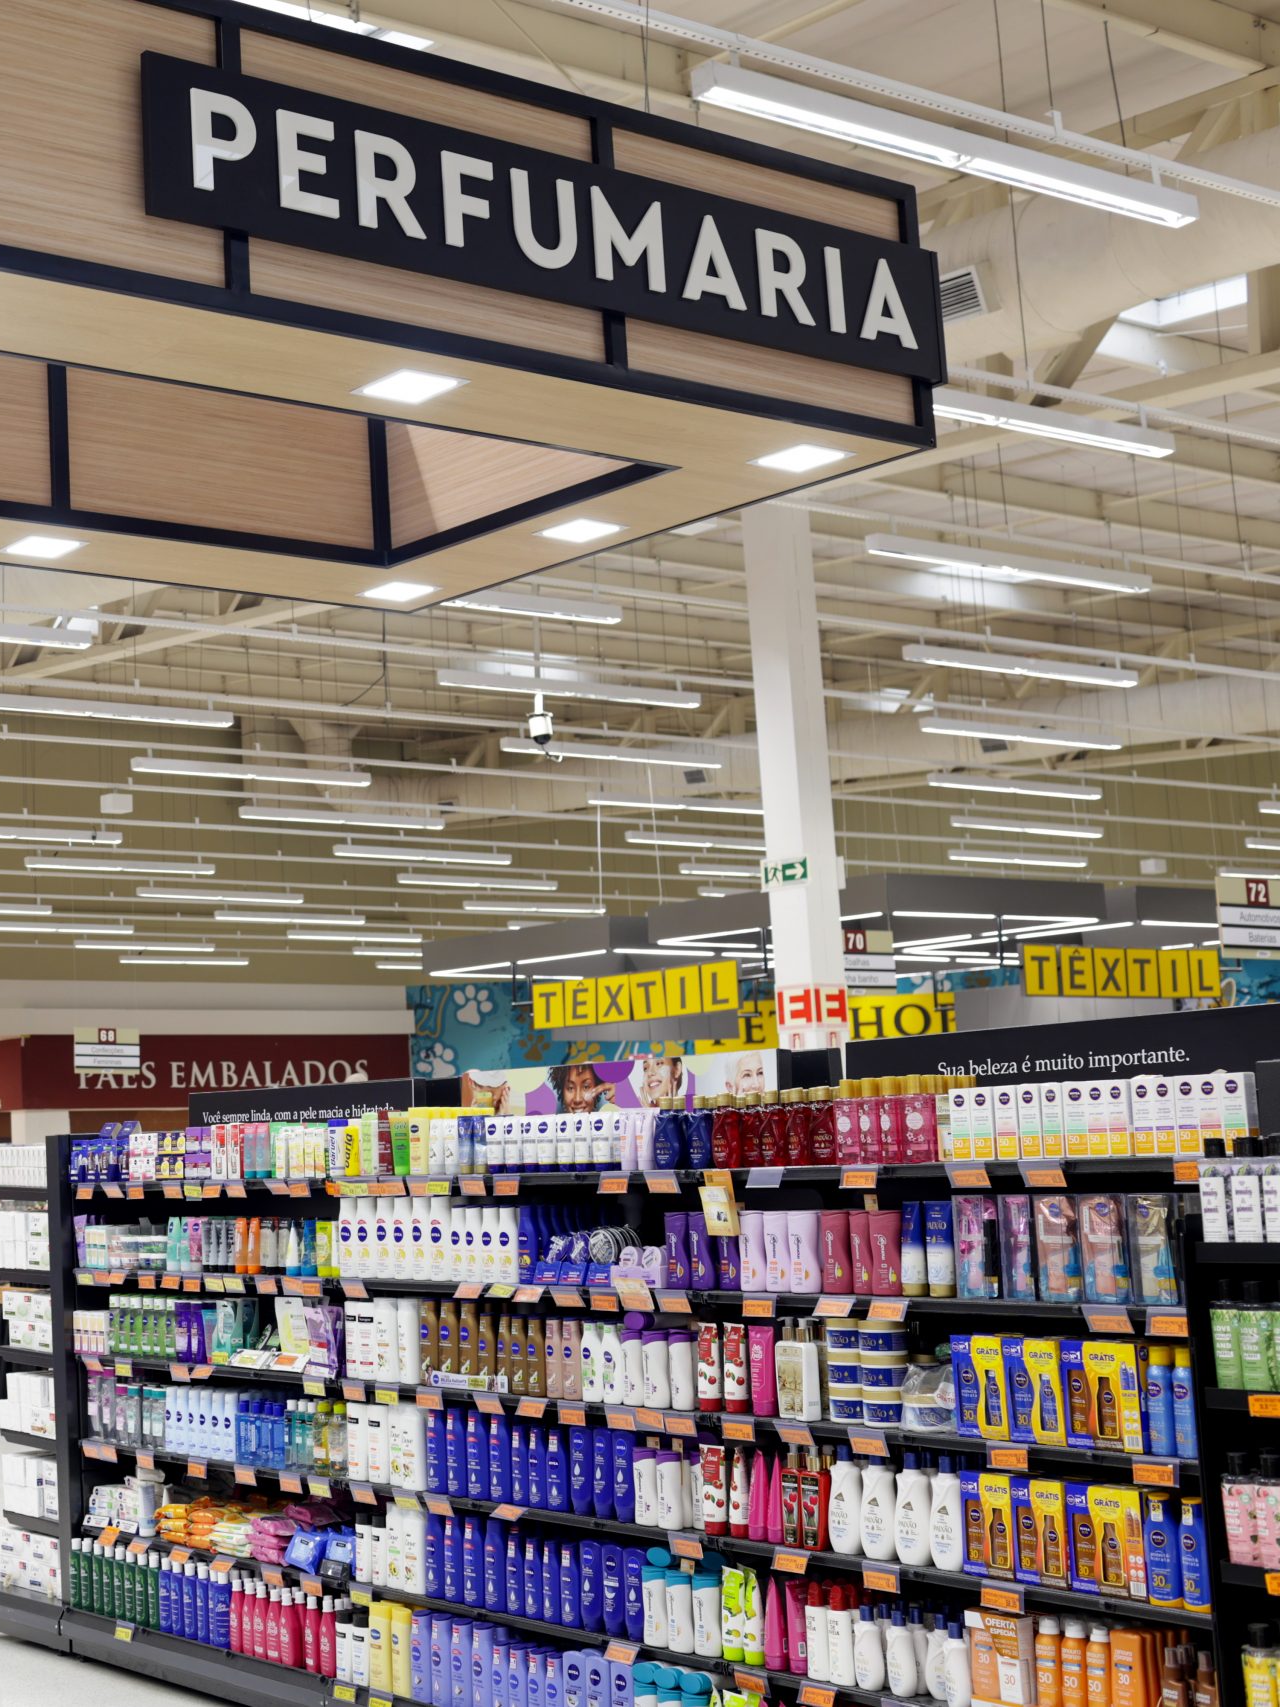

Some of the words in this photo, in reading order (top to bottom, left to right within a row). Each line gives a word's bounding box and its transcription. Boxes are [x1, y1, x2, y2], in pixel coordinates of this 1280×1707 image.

[190, 87, 918, 350] PERFUMARIA
[1248, 883, 1267, 902] 72
[847, 933, 865, 950] 70
[1031, 951, 1215, 991] TÊXTIL
[539, 965, 730, 1024] TÊXTIL
[100, 1030, 114, 1041] 68
[937, 1061, 965, 1077] Sua
[969, 1058, 1017, 1076] beleza
[1021, 1055, 1030, 1073] é
[1035, 1054, 1084, 1072] muito
[1088, 1047, 1190, 1073] importante.
[169, 1060, 368, 1089] EMBALADOS
[203, 1111, 221, 1124] Você
[222, 1112, 250, 1124] sempre
[251, 1110, 273, 1122] linda,
[275, 1113, 291, 1121] com
[300, 1106, 317, 1122] pele
[319, 1107, 344, 1119] macia
[976, 1344, 999, 1356] GRÁTIS
[1029, 1348, 1053, 1360] GRÁTIS
[1089, 1350, 1115, 1362] GRÁTIS
[984, 1484, 1007, 1494] GRÁTIS
[1035, 1489, 1059, 1501] GRÁTIS
[1094, 1495, 1120, 1509] GRÁTIS
[985, 1617, 1016, 1630] OFERTA
[989, 1628, 1017, 1638] ESPECIAL
[1038, 1671, 1053, 1685] 50
[1063, 1676, 1078, 1689] 50
[1087, 1680, 1102, 1693] 50
